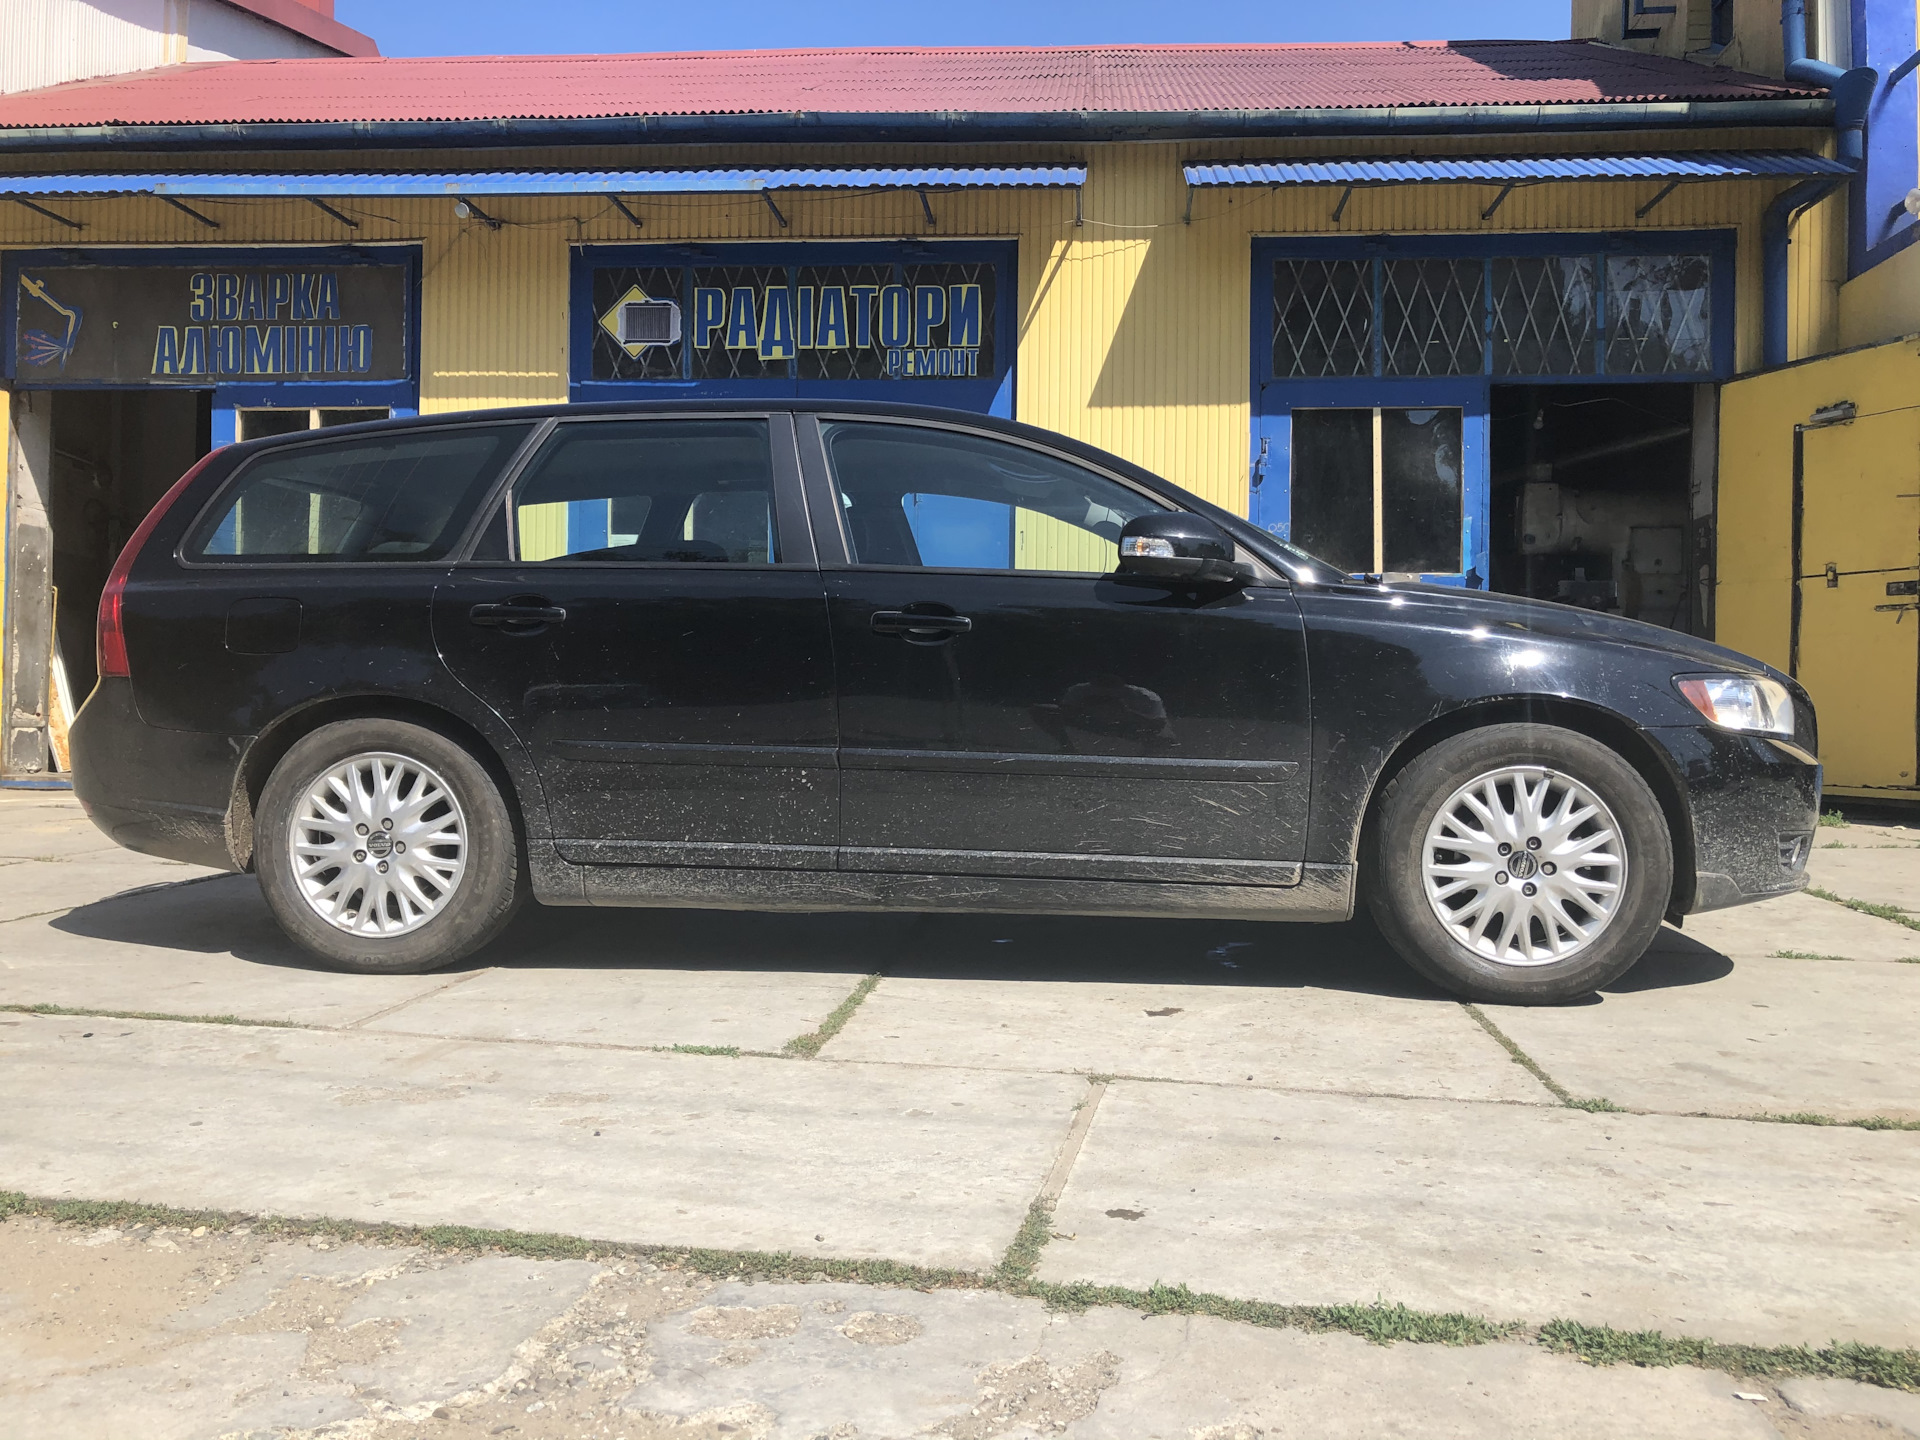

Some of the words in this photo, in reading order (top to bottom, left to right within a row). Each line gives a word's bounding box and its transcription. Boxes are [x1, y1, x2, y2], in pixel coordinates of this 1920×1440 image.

[191, 273, 340, 321] ЗВАРКА
[694, 284, 982, 360] РАДІАТОРИ
[152, 325, 373, 374] АЛЮМІНІЮ
[887, 348, 980, 376] РЕМОНТ
